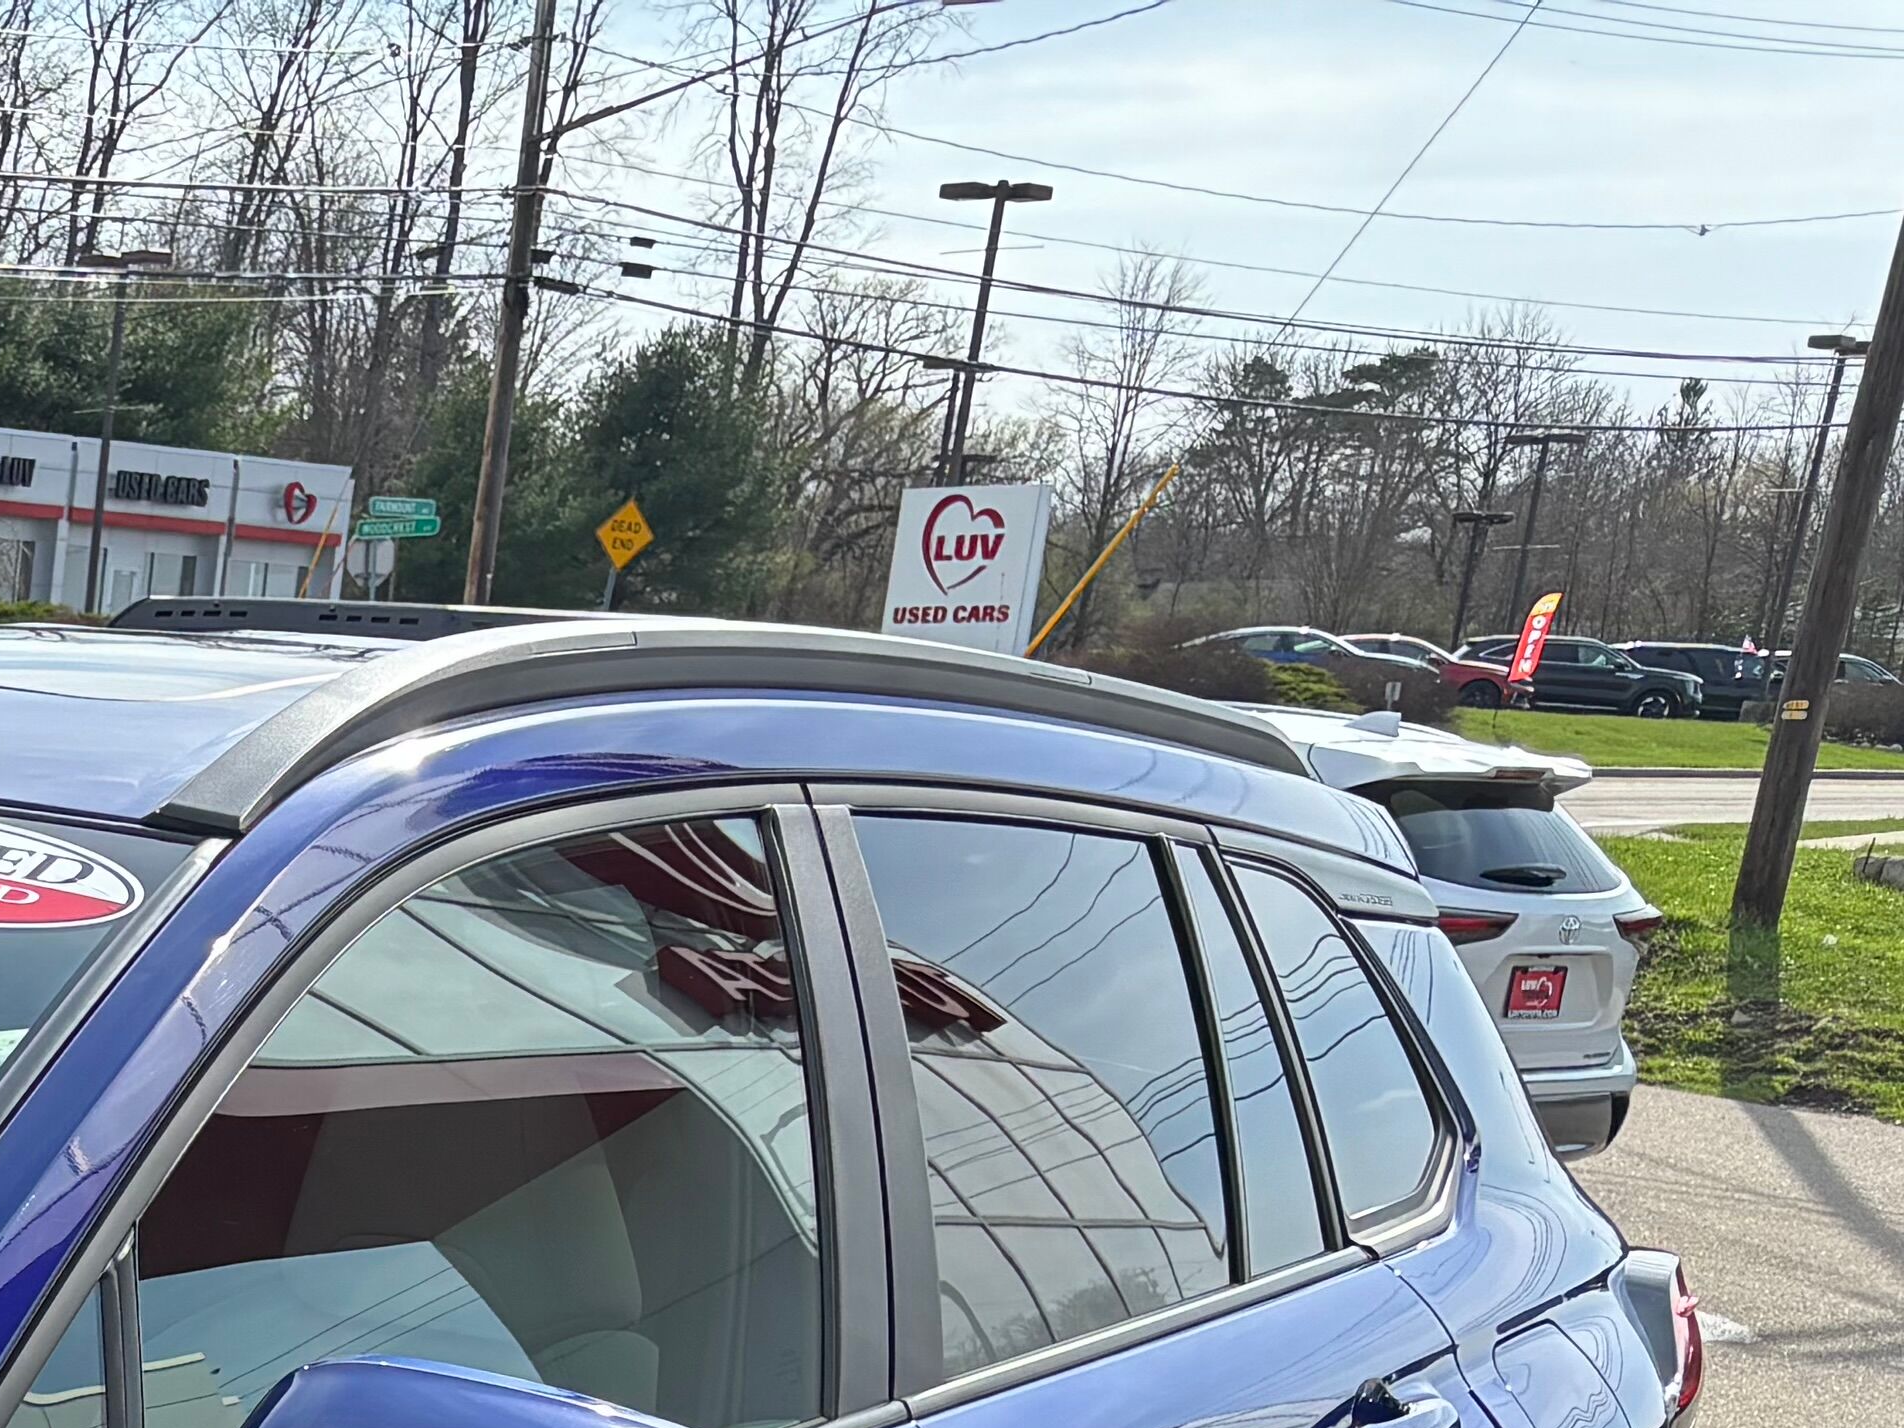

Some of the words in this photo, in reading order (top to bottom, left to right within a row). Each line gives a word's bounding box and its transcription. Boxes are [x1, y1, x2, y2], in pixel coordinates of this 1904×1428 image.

[0, 455, 36, 487] LUV
[115, 470, 162, 501] USED
[611, 520, 642, 534] DEAD
[612, 537, 634, 551] END
[933, 533, 1005, 561] LUV
[893, 605, 947, 624] USED
[952, 604, 1010, 623] CARS
[1518, 615, 1547, 673] OPEN
